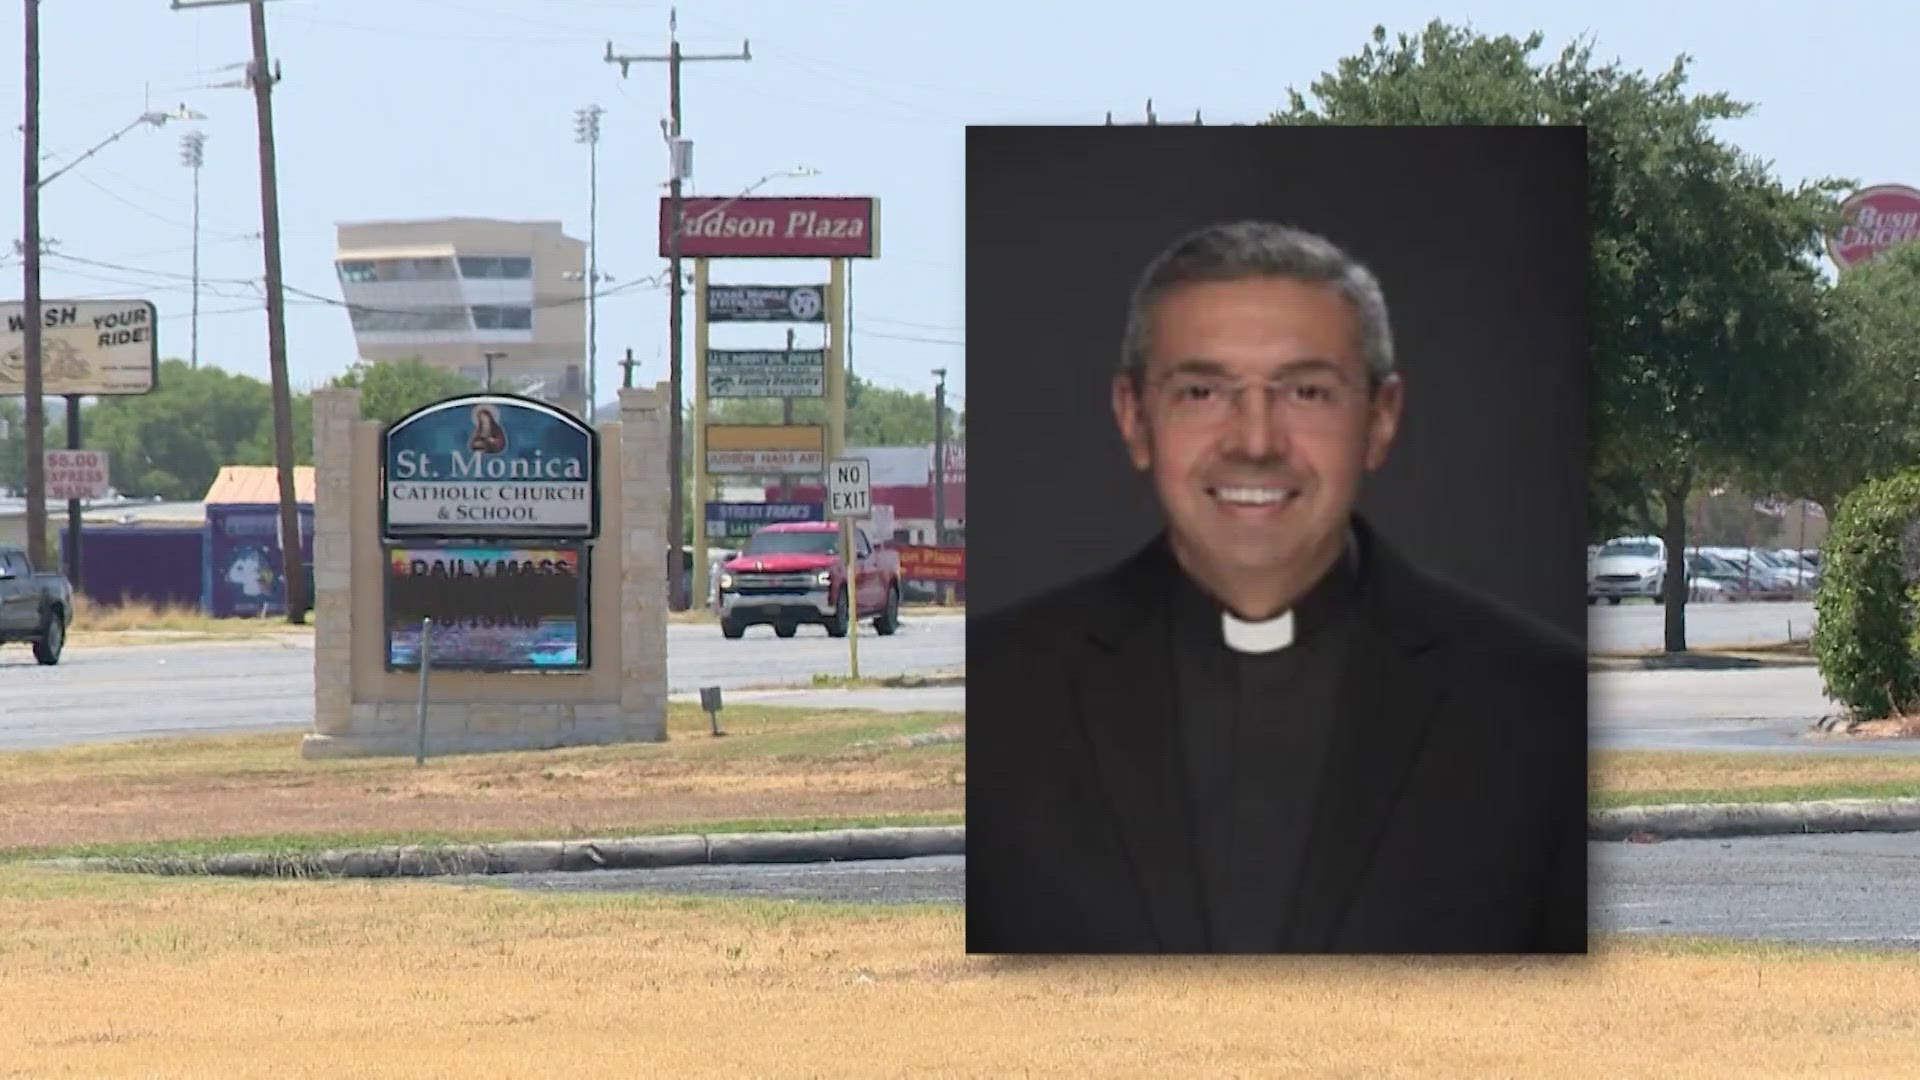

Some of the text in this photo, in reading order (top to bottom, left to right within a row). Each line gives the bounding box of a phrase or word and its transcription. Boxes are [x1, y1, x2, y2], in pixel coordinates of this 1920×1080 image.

[672, 211, 863, 239] udson Plaza
[1831, 226, 1920, 248] CHICKE
[8, 307, 147, 332] WSH YOUR
[396, 449, 582, 478] St. Monica
[799, 453, 821, 464] ART
[838, 466, 860, 483] NO
[499, 486, 585, 501] CHURCH
[832, 492, 866, 510] EXIT
[437, 505, 538, 521] & SCHOOL
[410, 560, 490, 577] DAILY
